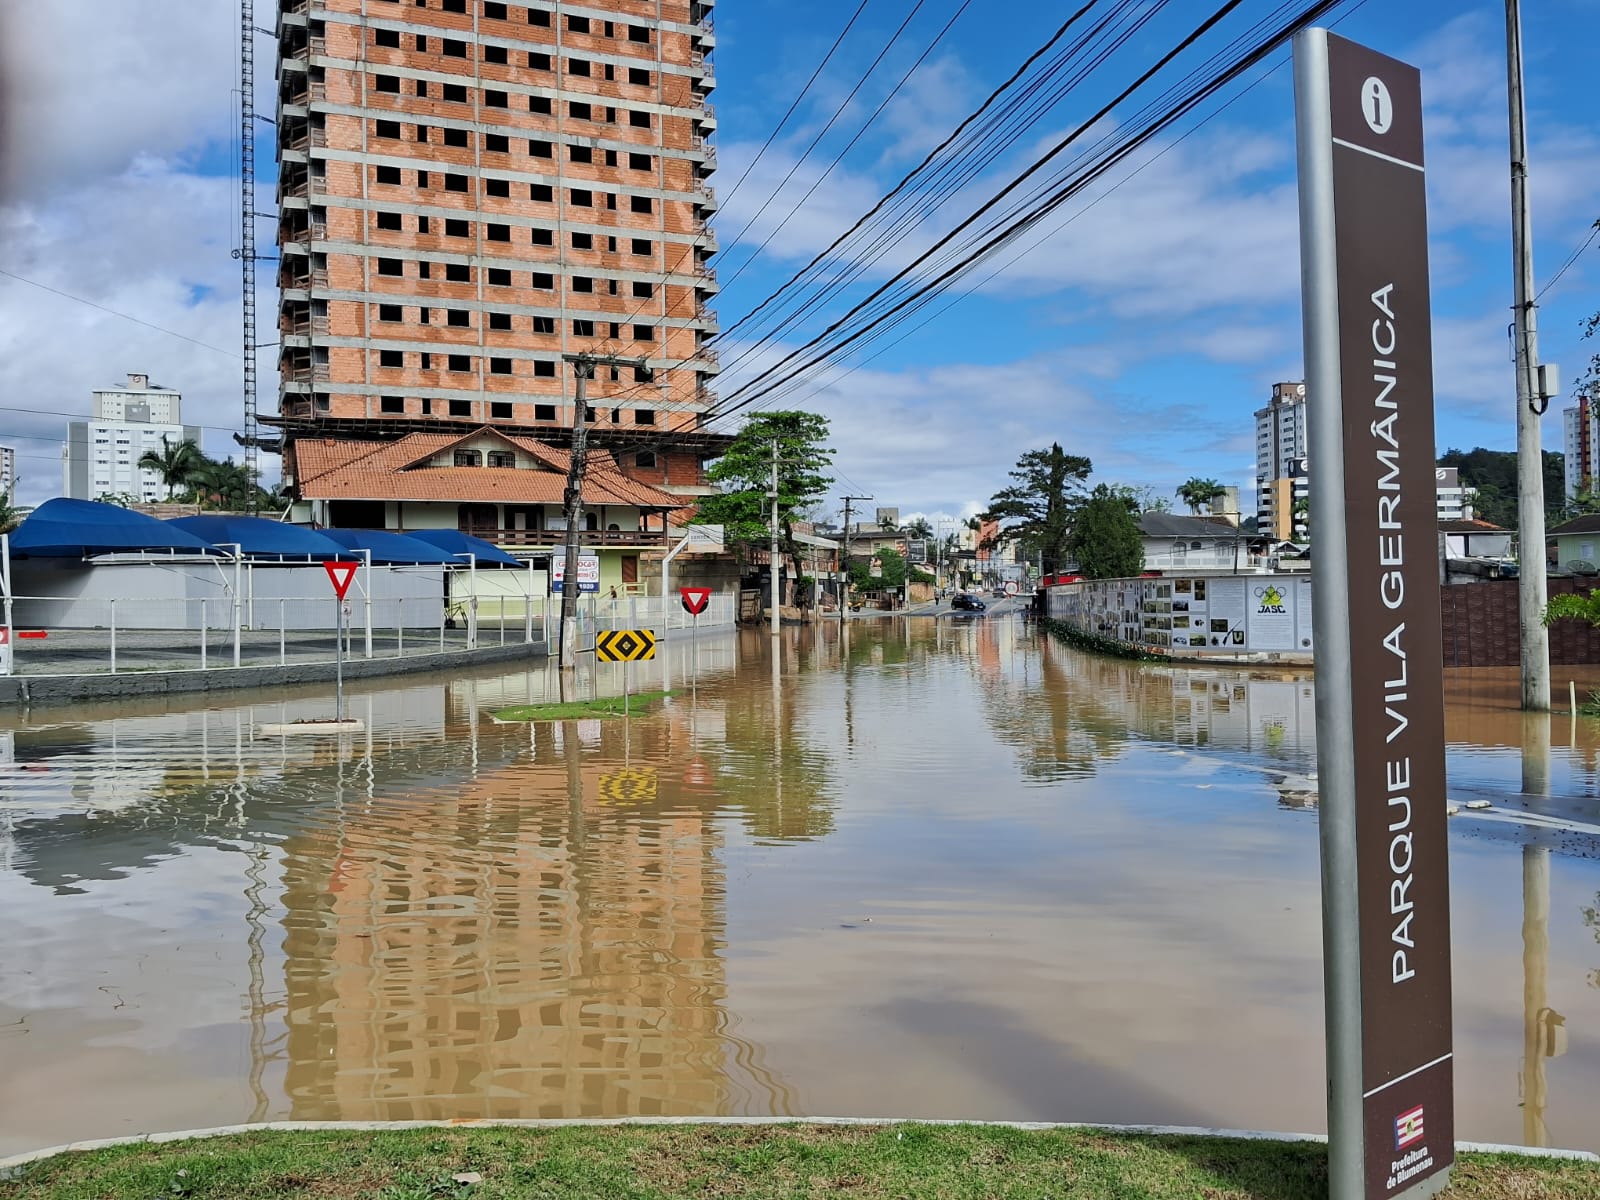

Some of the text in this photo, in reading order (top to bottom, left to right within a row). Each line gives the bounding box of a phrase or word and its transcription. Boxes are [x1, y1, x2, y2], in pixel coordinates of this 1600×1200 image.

[1257, 605, 1286, 614] JASC
[1370, 283, 1416, 984] PARQUE VILA GERMÂNICA
[1386, 1156, 1433, 1190] de Blumenau
[1391, 1146, 1428, 1174] Prefeitura
